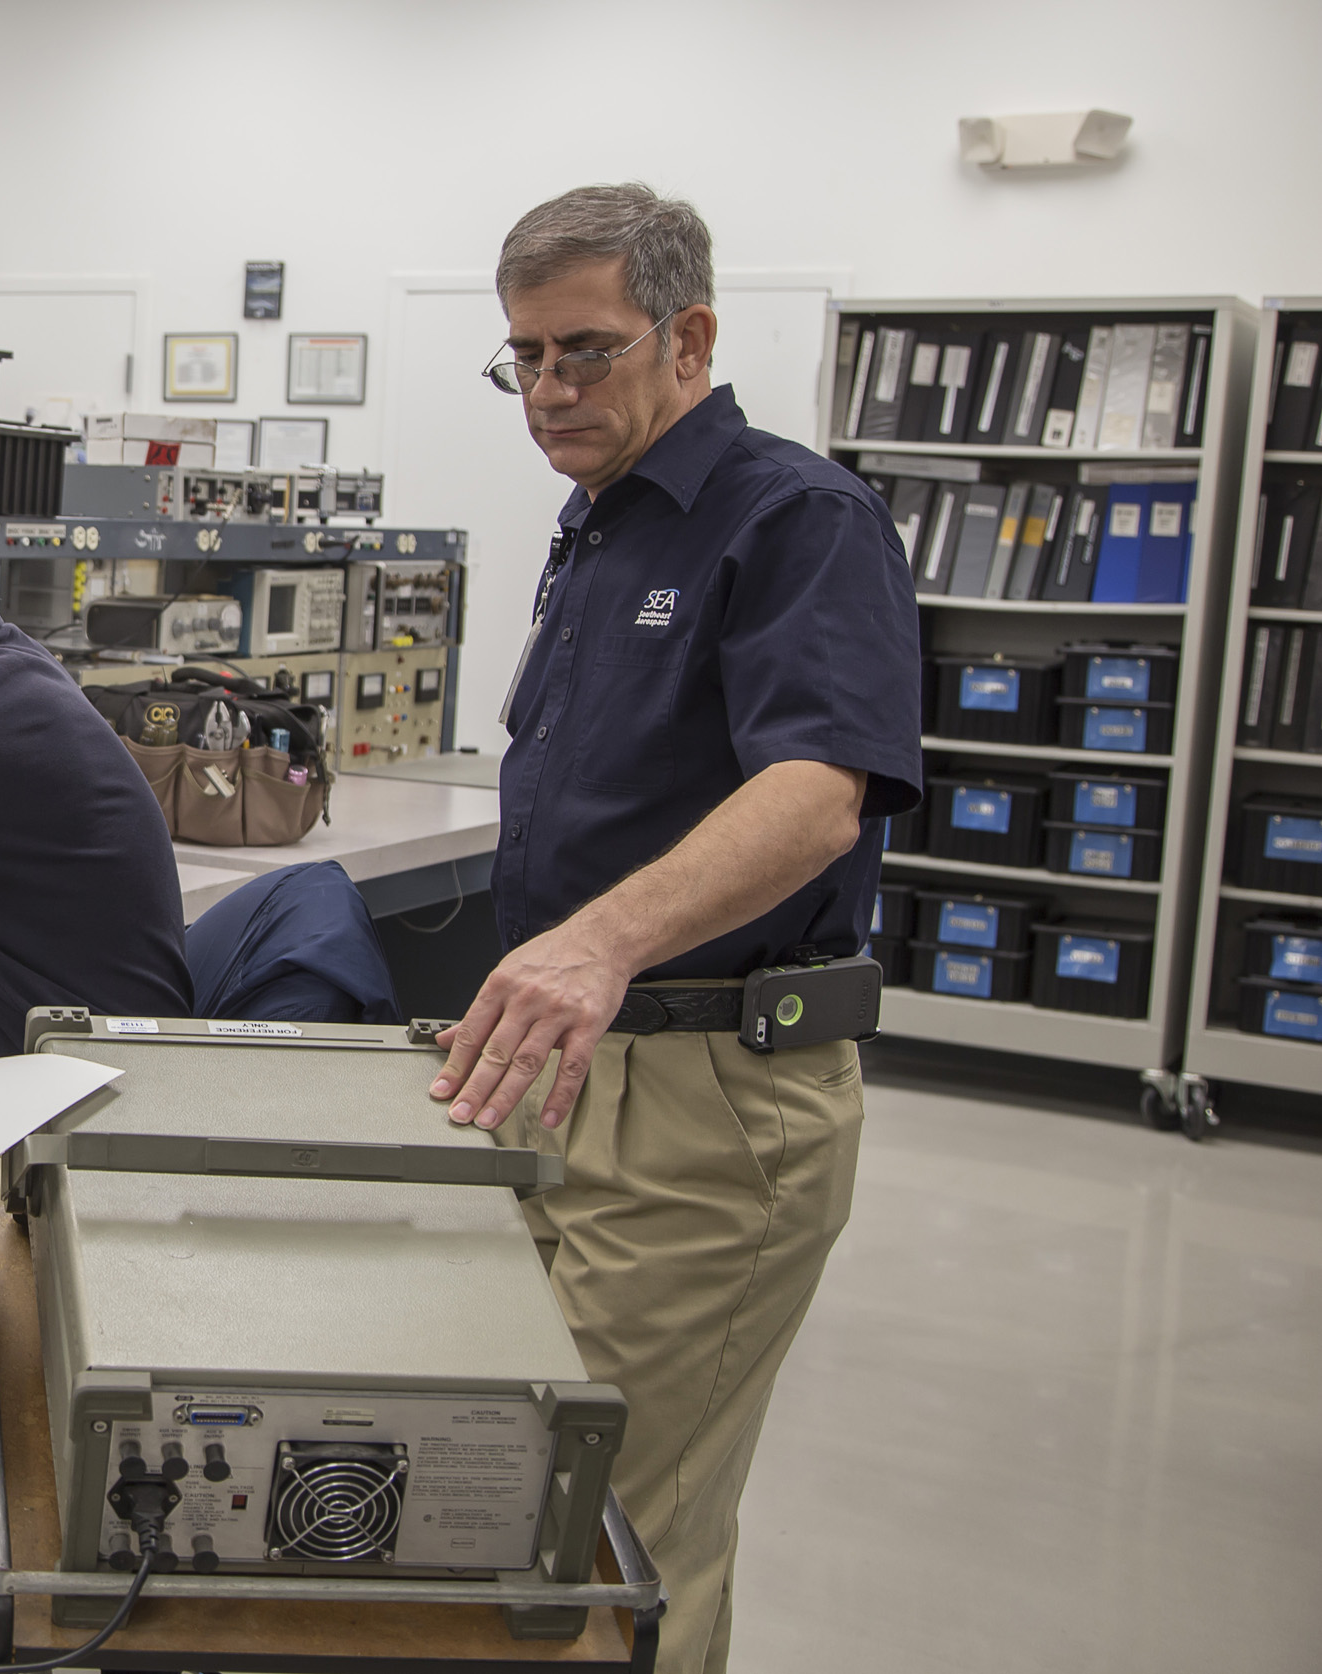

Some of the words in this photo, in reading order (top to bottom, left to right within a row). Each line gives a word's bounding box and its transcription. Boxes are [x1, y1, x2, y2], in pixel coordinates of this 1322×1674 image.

[643, 590, 675, 610] SEA
[638, 610, 672, 619] Southeast
[635, 617, 670, 627] Aerospace
